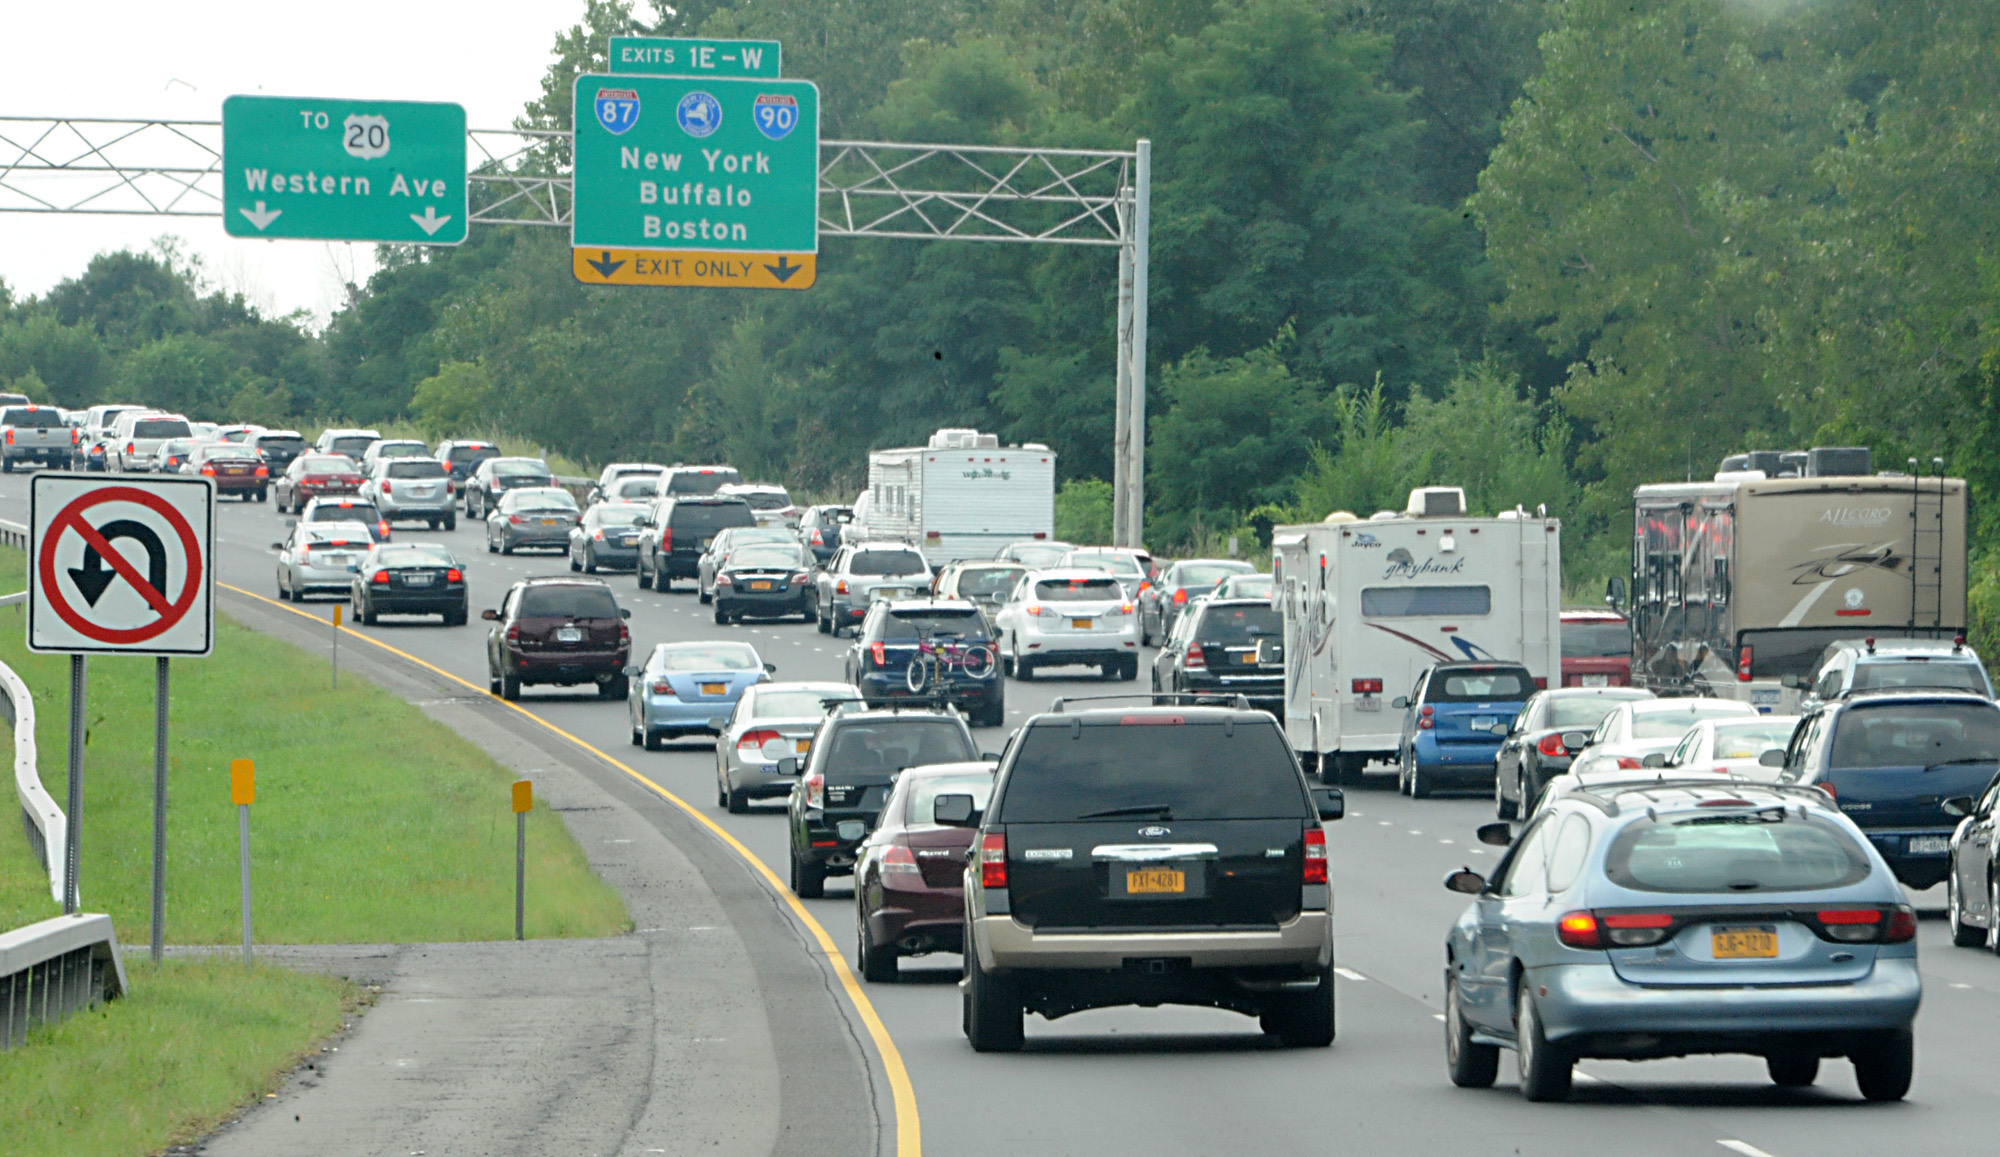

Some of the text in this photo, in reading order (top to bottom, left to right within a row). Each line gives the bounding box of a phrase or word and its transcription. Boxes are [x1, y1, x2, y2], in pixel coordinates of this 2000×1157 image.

[621, 47, 675, 63] EXITS
[300, 111, 329, 129] TO
[603, 101, 634, 123] 87
[761, 106, 792, 129] 90
[348, 124, 385, 149] 20
[621, 147, 770, 174] New York
[244, 168, 447, 198] Western Ave
[640, 180, 751, 207] Buffalo
[643, 214, 747, 241] Boston
[635, 258, 753, 277] EXIT ONLY
[1351, 540, 1382, 549] Jayco
[1383, 557, 1464, 580] greyhawk
